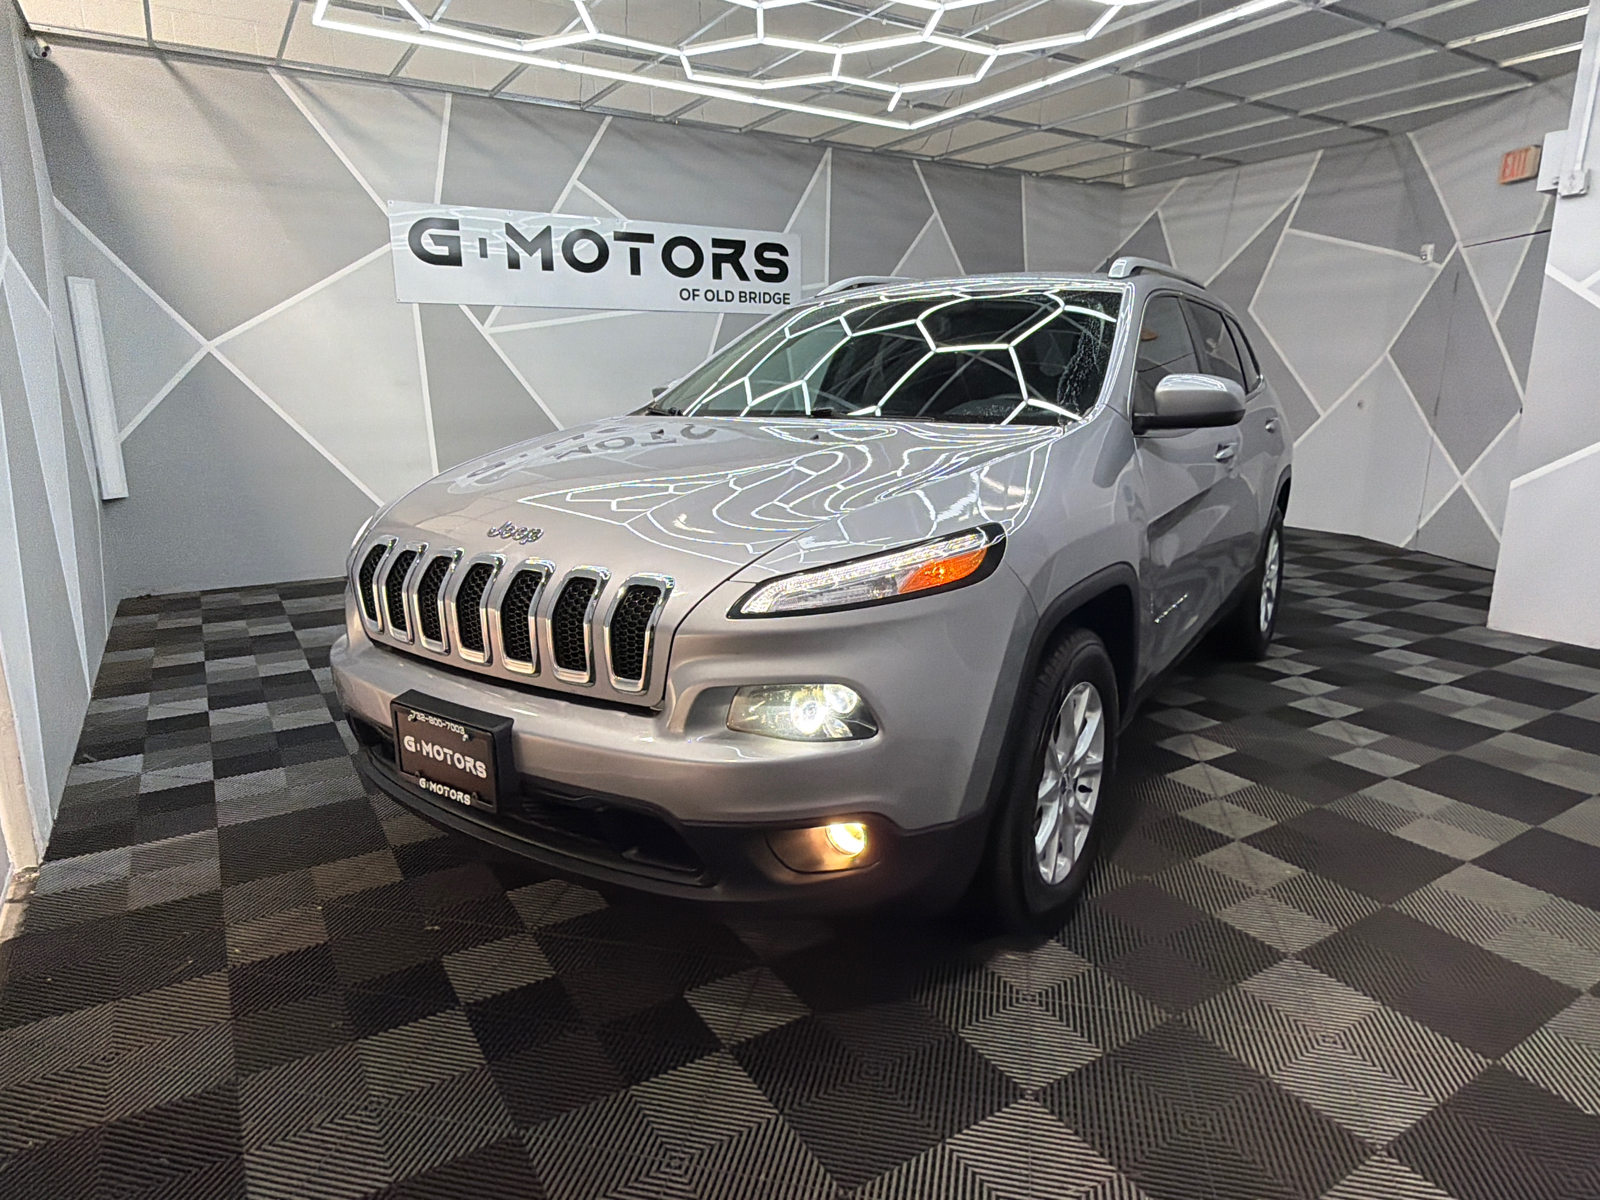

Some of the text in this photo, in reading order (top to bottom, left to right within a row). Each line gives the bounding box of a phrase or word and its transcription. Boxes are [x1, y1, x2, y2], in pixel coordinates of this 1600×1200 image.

[679, 287, 791, 305] OF OLD BRIDGE
[486, 520, 544, 545] Jeep
